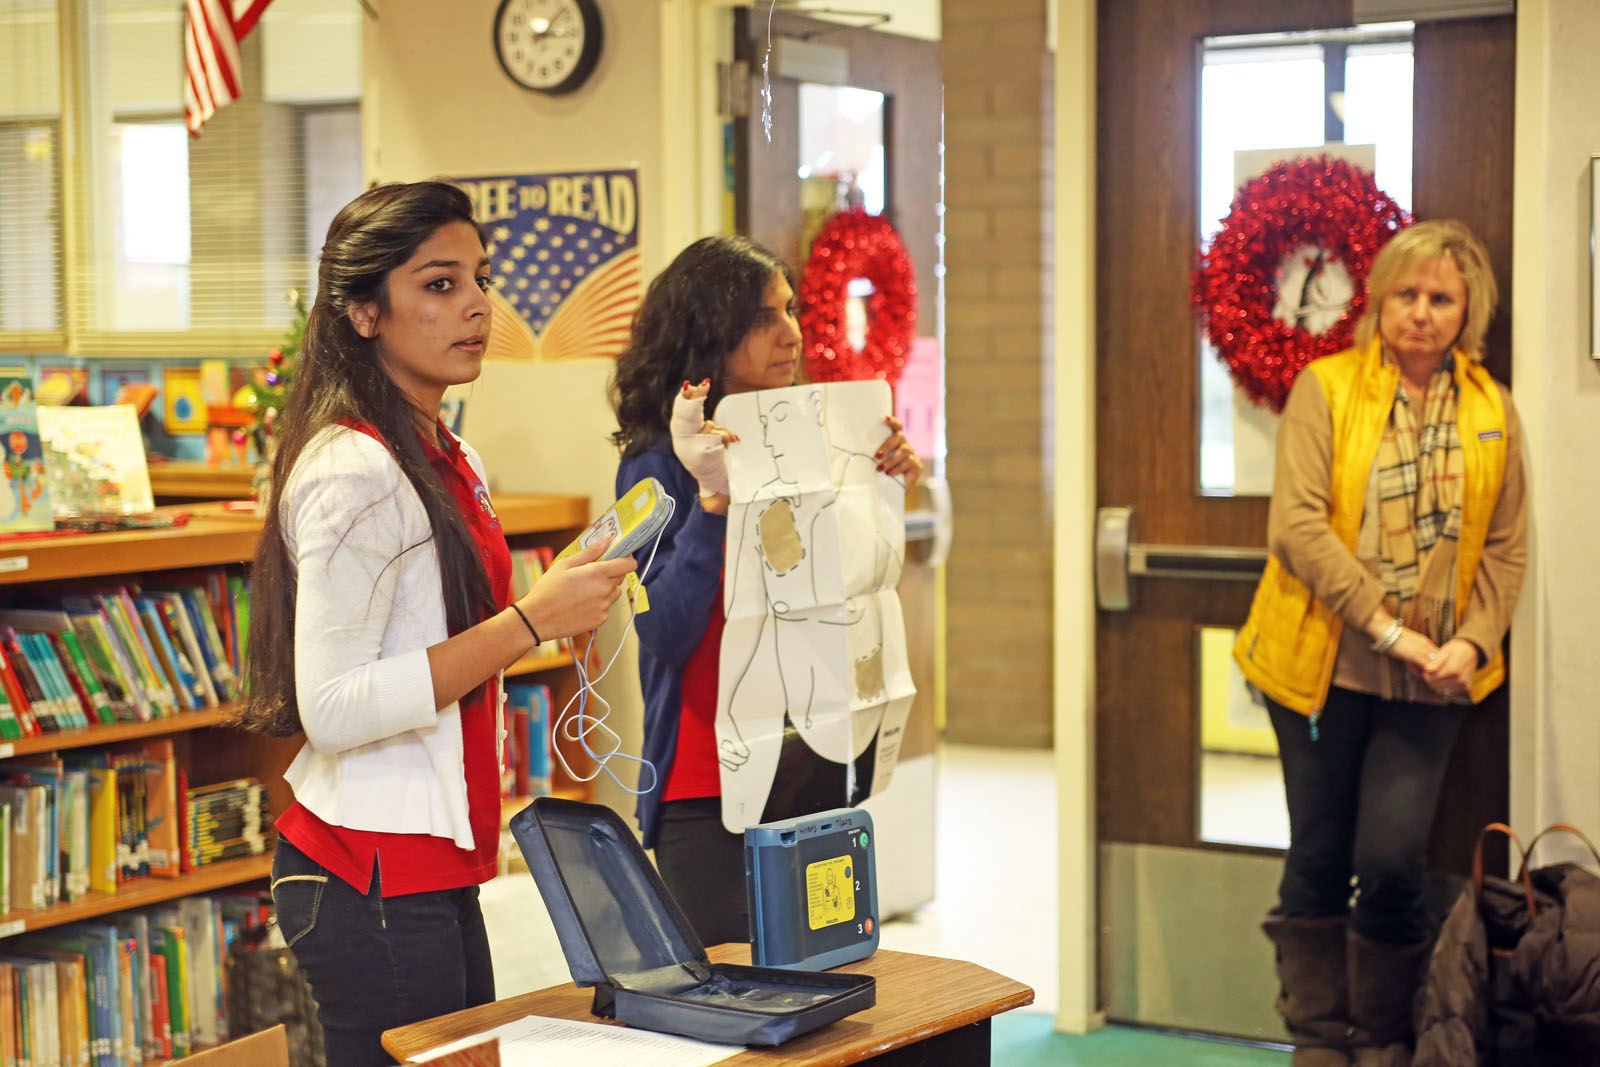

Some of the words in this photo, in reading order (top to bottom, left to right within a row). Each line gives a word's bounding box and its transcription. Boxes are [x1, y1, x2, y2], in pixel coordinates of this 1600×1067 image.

[548, 174, 636, 235] READ
[851, 836, 857, 848] 1
[854, 880, 861, 891] 2
[857, 923, 864, 934] 3
